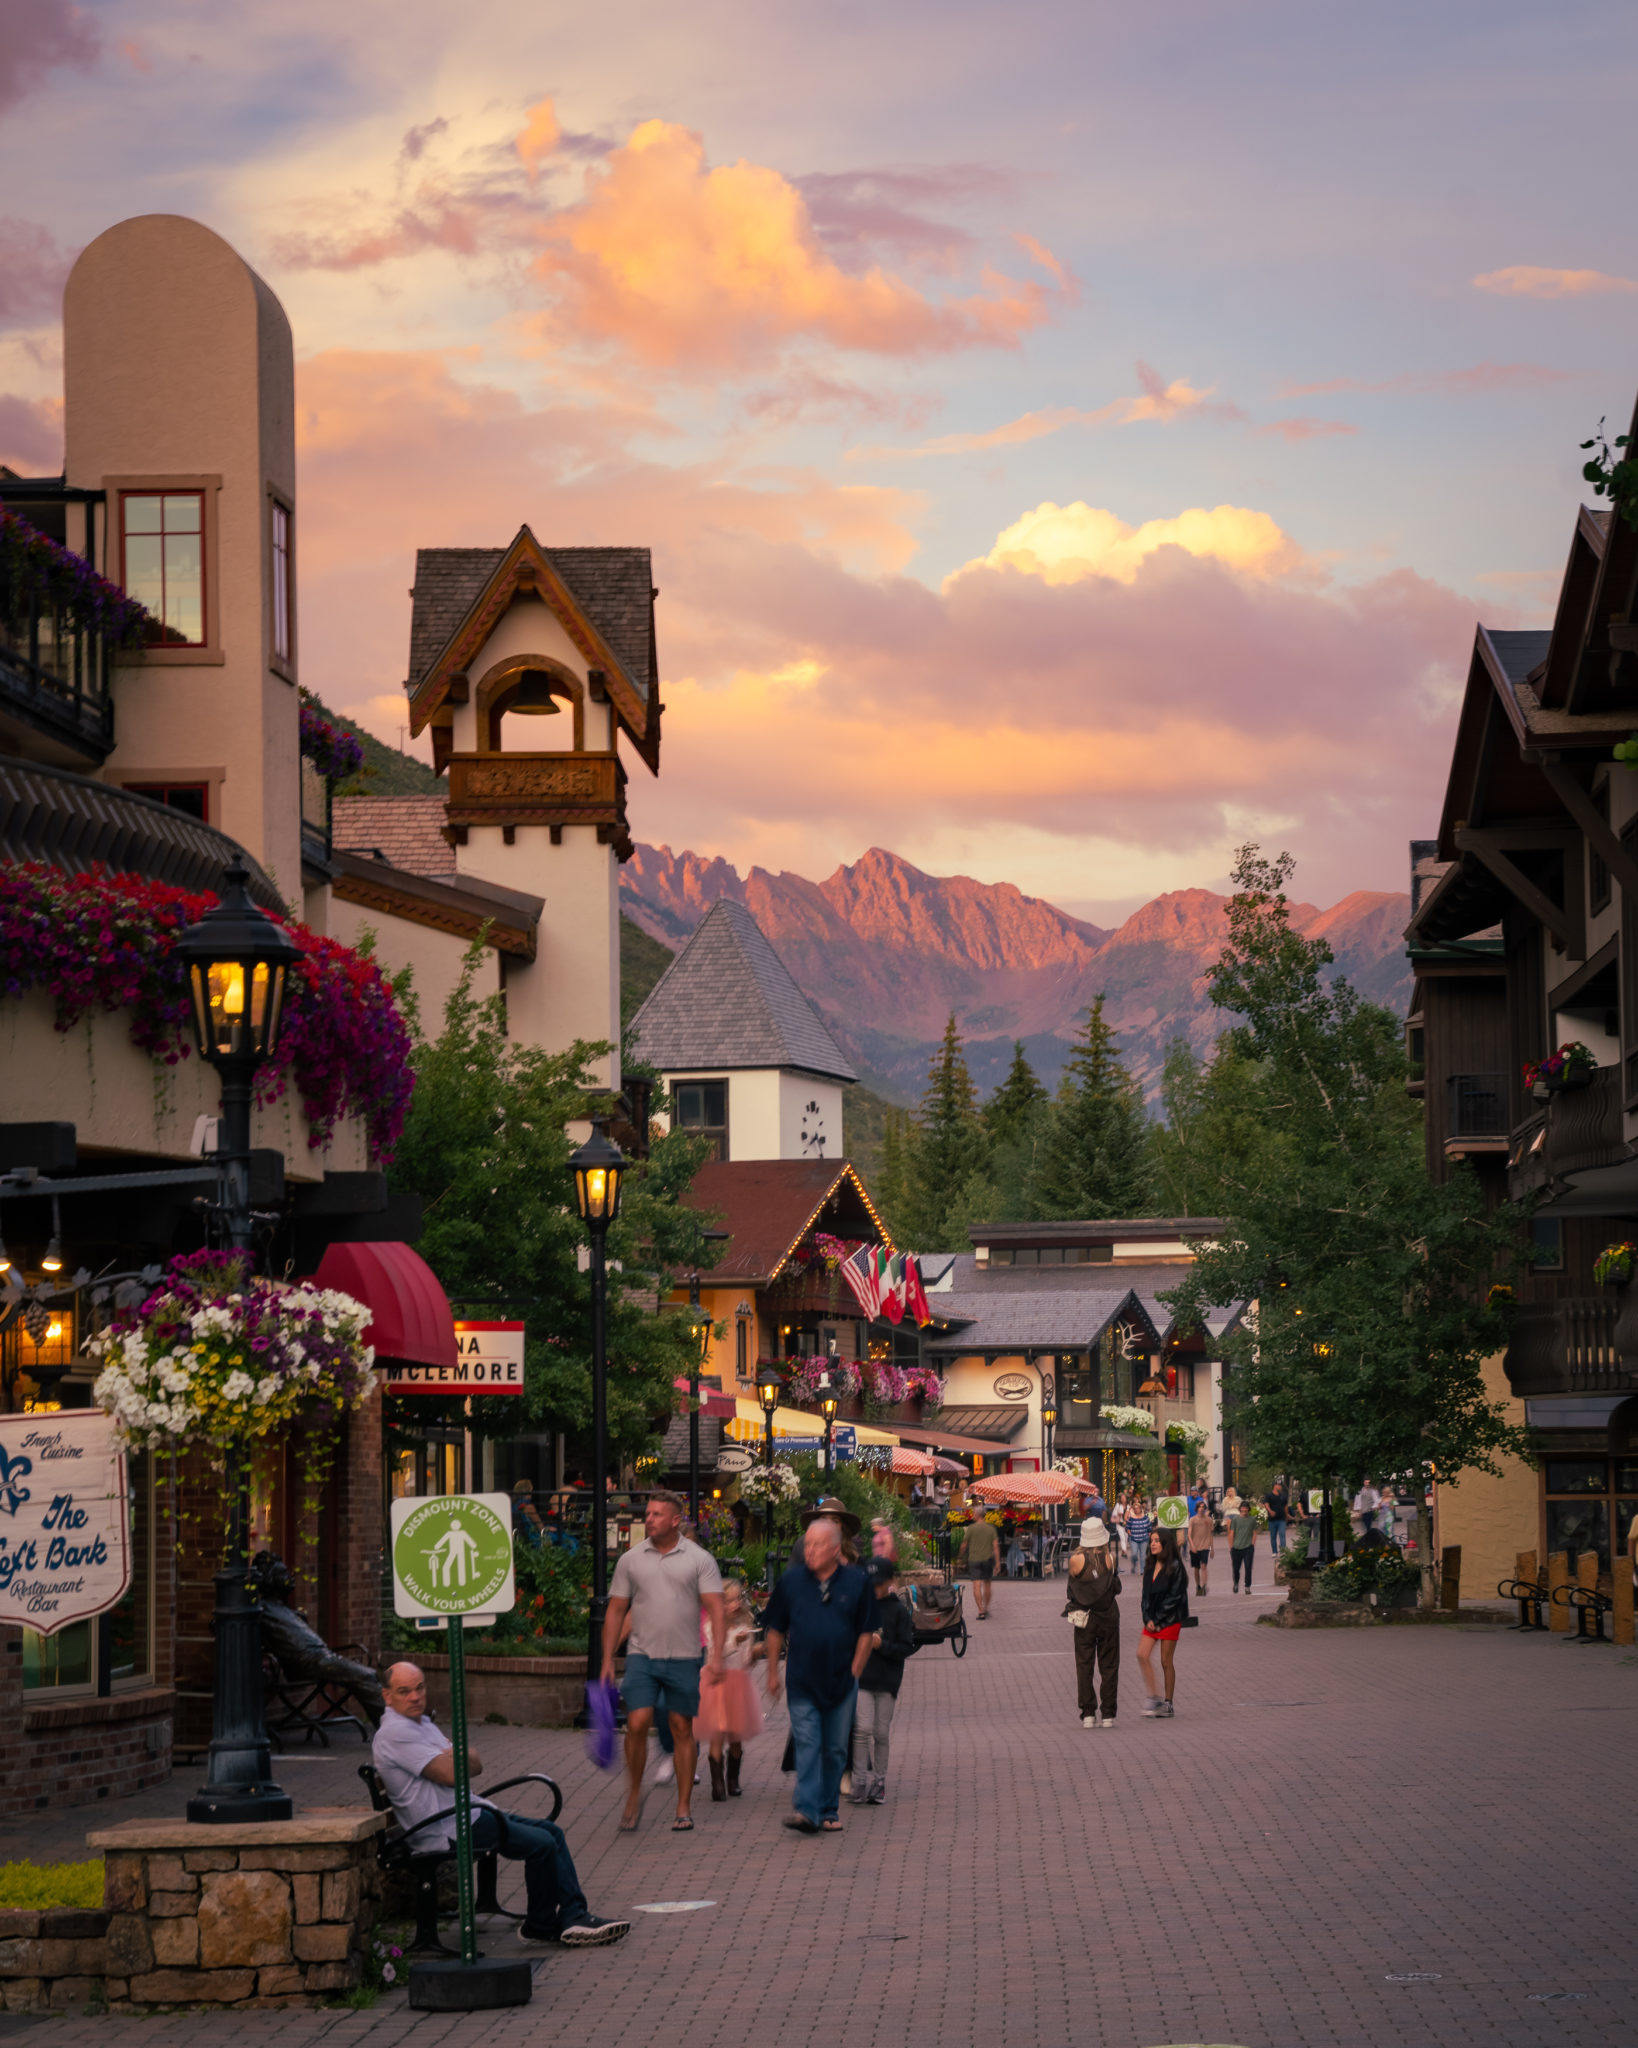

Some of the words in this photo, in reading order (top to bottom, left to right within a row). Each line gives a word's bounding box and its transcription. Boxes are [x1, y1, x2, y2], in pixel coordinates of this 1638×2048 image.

[387, 1363, 518, 1381] MCLEMORE
[20, 1431, 62, 1448] French
[40, 1446, 84, 1460] Cuisine
[41, 1493, 89, 1530] The
[403, 1499, 470, 1538] DISMOUNT
[470, 1504, 502, 1535] ZONE
[0, 1537, 38, 1589] eft
[45, 1533, 108, 1570] Bank
[10, 1576, 86, 1600] Restaurant
[403, 1573, 431, 1604] WALK
[433, 1599, 466, 1610] YOUR
[469, 1567, 506, 1606] WHEELS
[27, 1597, 59, 1613] Bar
